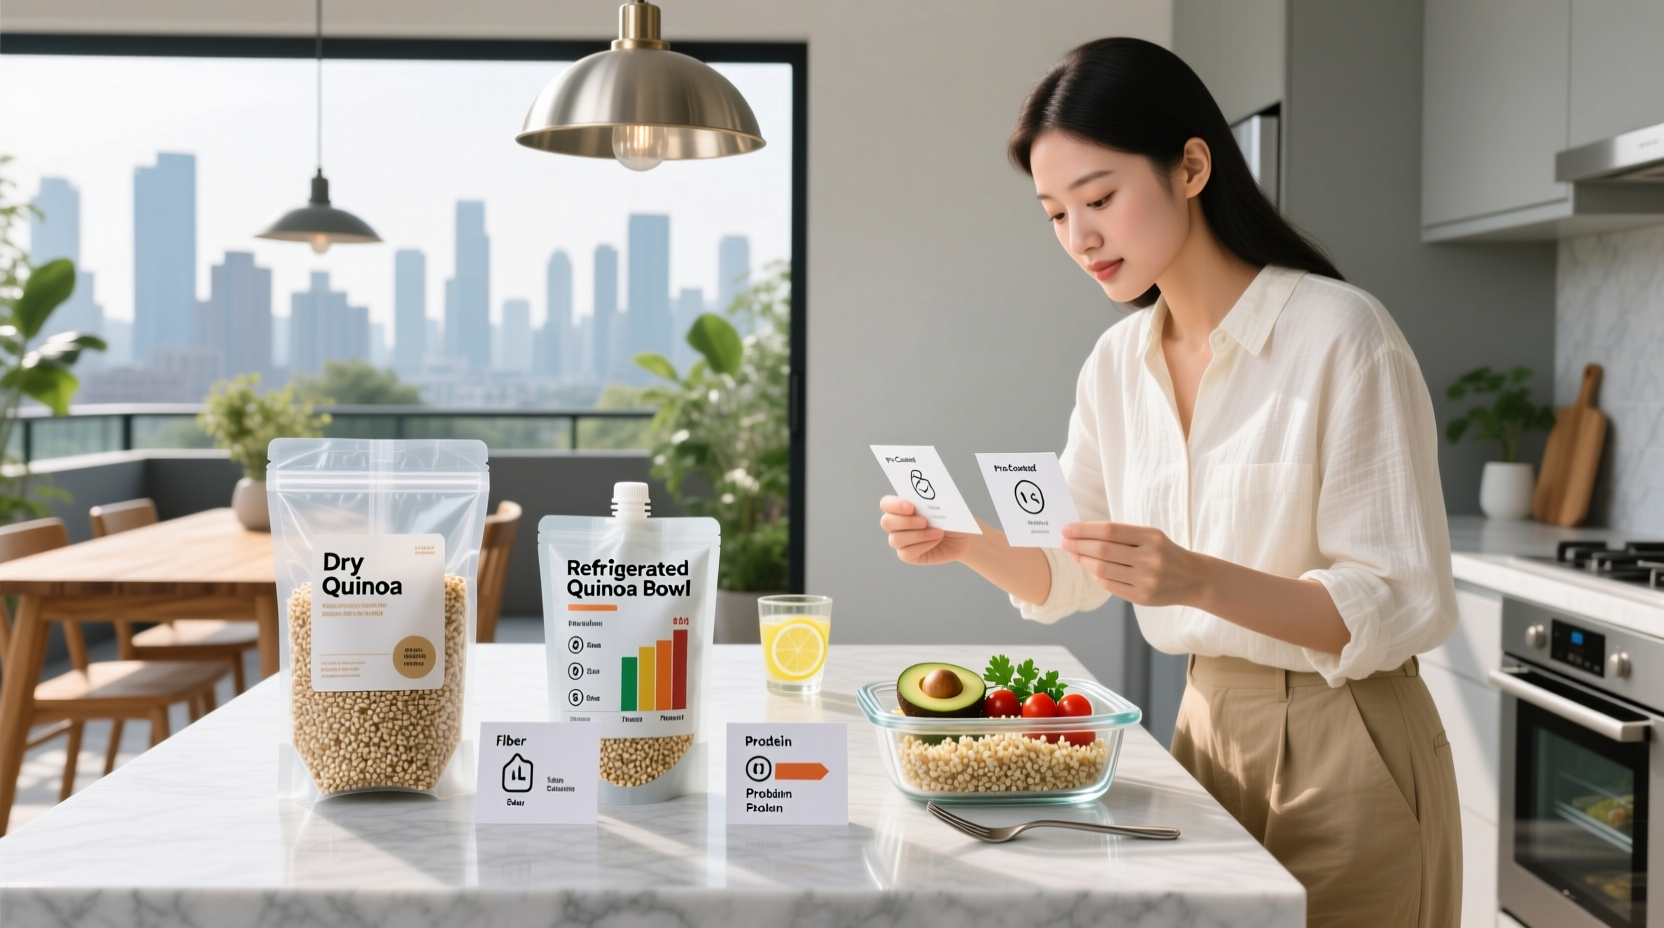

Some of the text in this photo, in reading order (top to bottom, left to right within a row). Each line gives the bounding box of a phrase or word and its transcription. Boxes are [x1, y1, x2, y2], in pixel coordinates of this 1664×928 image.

[323, 552, 364, 576] Dry
[567, 559, 689, 581] Refrigerated
[322, 576, 402, 598] Quinoa
[567, 579, 691, 599] Quinoa Bowl
